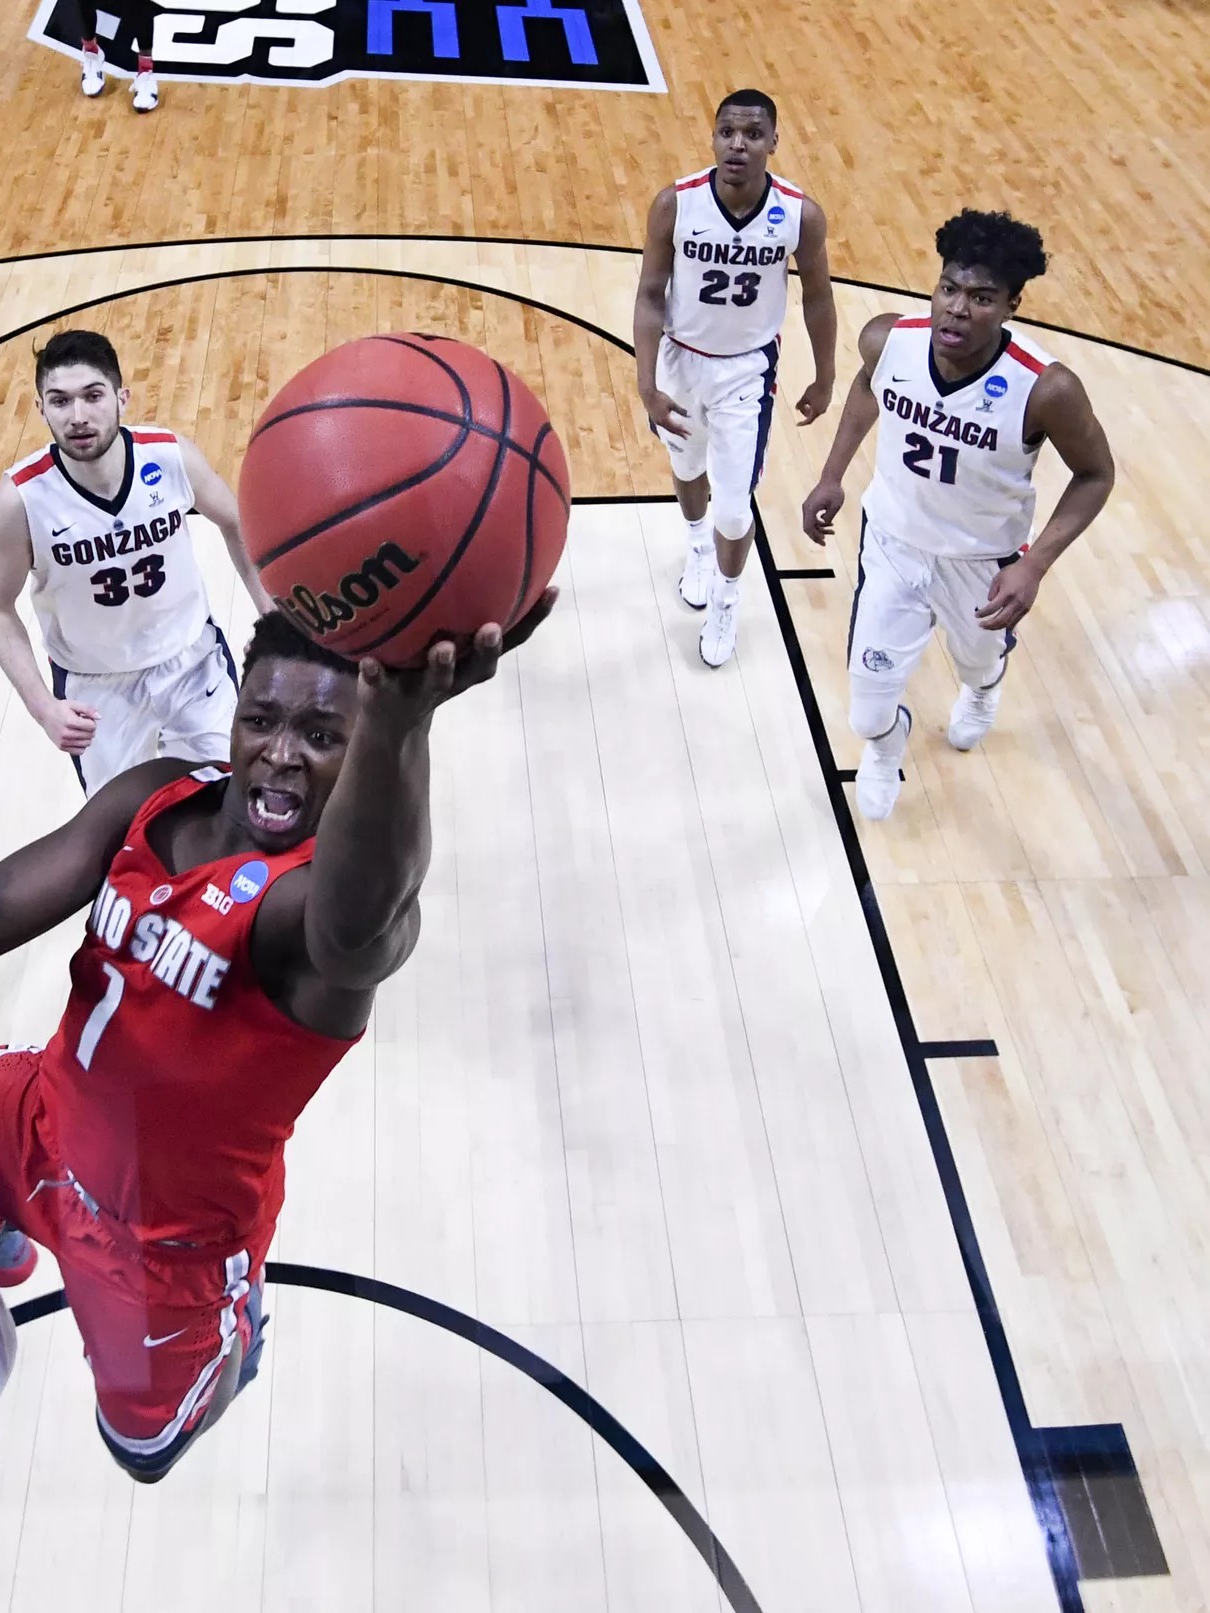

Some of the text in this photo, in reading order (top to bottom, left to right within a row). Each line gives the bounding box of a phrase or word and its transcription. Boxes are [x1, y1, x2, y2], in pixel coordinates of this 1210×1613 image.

[683, 240, 786, 266] GONZAGA
[698, 269, 762, 308] 23
[882, 388, 998, 451] GONZAGA
[902, 431, 960, 486] 21
[51, 509, 182, 566] GONZAGA
[89, 553, 167, 607] 33
[273, 540, 421, 636] ilson
[130, 912, 232, 1010] STATE
